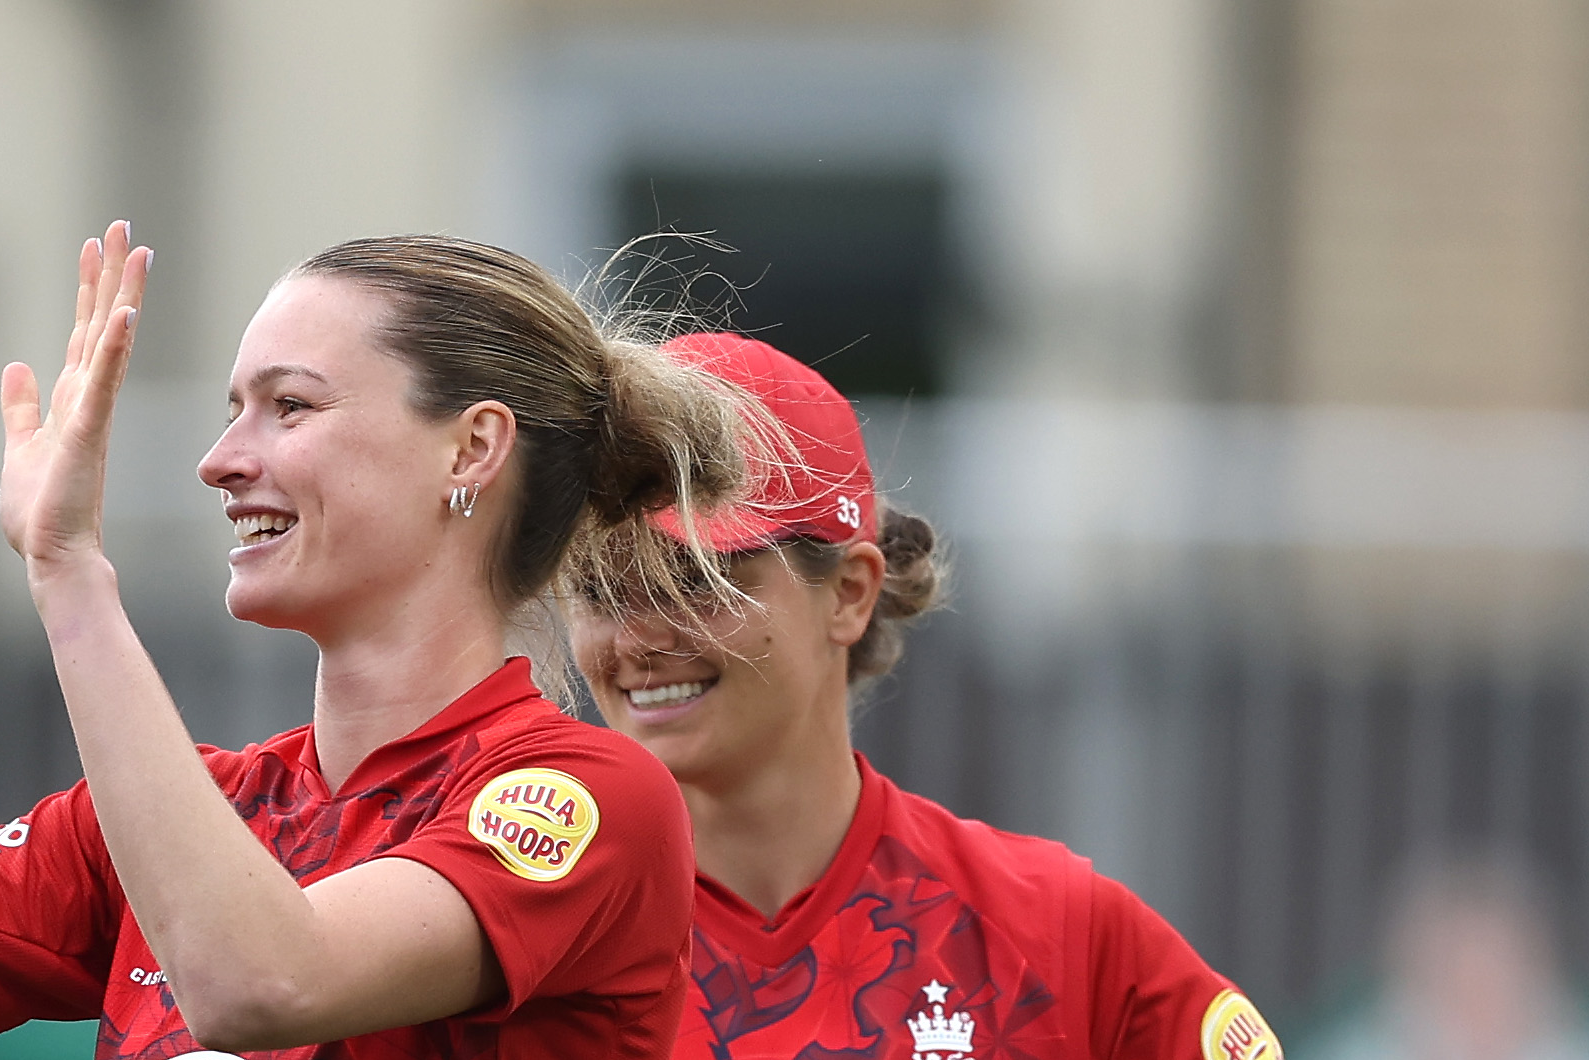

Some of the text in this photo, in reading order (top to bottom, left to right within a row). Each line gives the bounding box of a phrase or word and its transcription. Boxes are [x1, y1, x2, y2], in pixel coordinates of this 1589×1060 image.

[837, 495, 860, 529] 33
[495, 785, 576, 826] HULA
[481, 810, 571, 865] HOOPS
